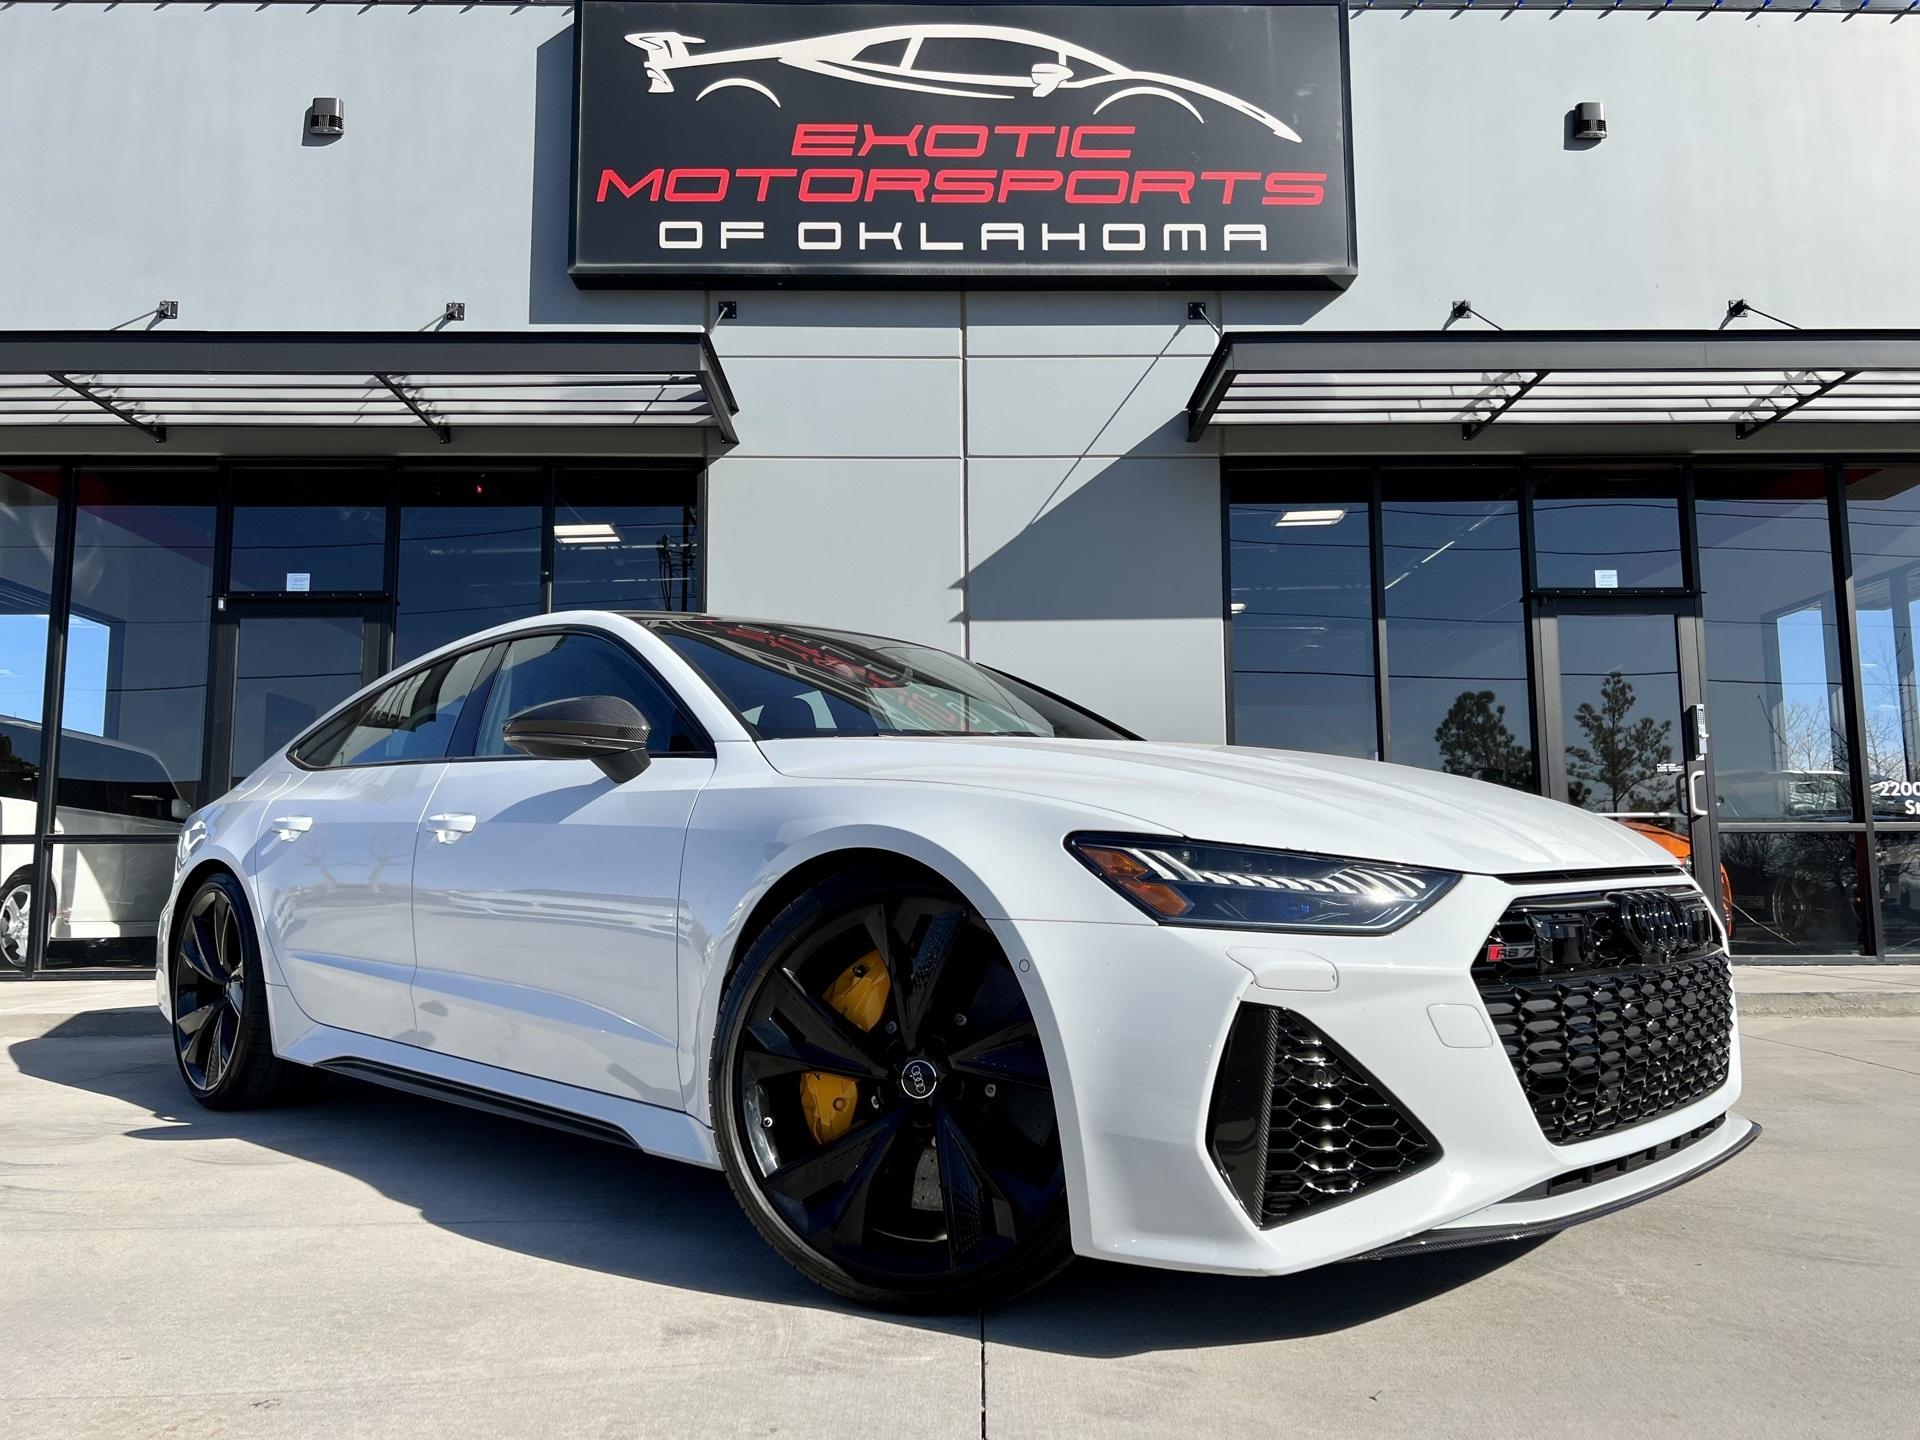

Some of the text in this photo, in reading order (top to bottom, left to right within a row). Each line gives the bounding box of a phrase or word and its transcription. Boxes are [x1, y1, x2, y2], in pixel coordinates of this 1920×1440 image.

[791, 123, 1136, 158] EXOTIC
[596, 167, 1328, 206] MOTORSPORTS
[658, 220, 1268, 253] OF OKLAHOMA
